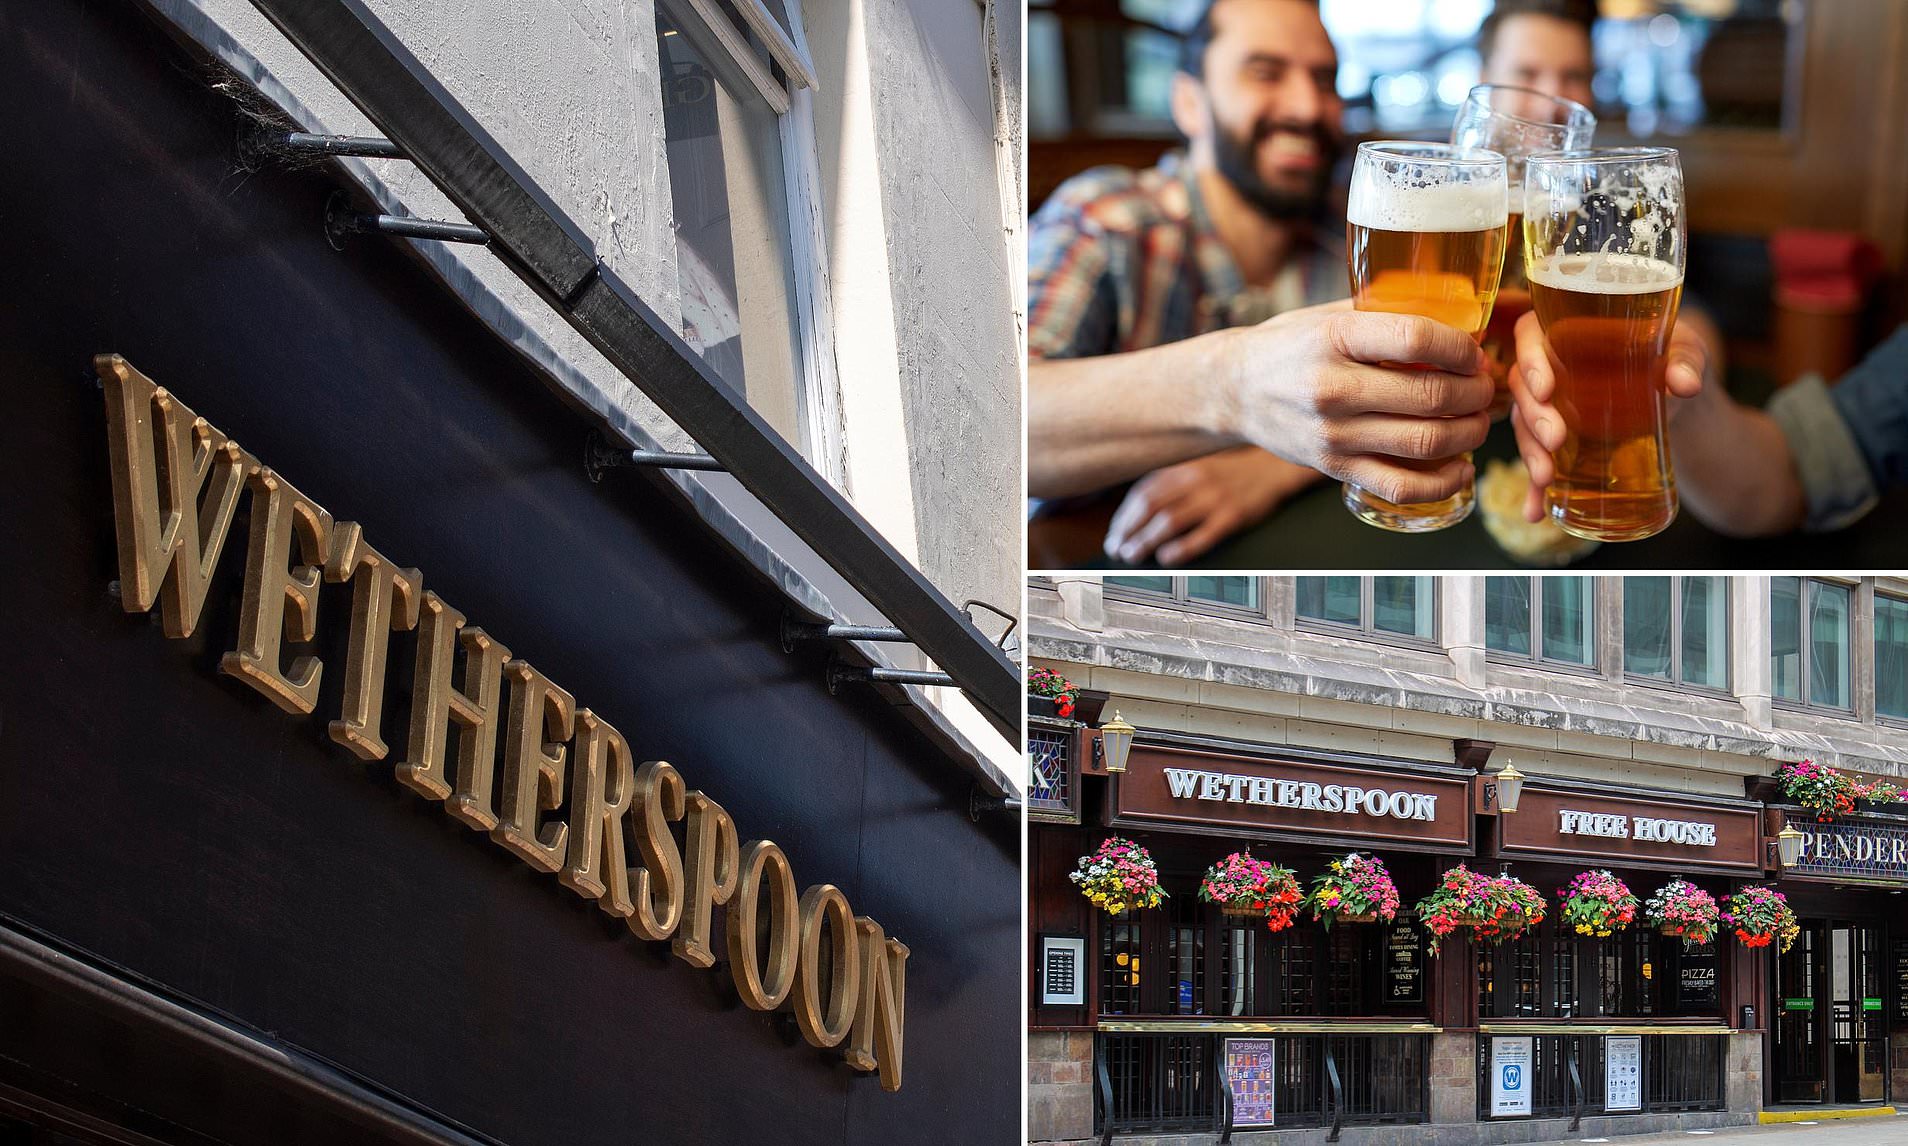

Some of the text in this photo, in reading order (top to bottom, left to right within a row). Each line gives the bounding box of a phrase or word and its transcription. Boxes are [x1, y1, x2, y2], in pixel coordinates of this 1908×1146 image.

[93, 353, 910, 1093] WETHERSPOON
[1163, 767, 1438, 822] WETHERSPOON
[1559, 809, 1717, 846] FREE HOUSE
[1799, 832, 1908, 864] PENDER
[1681, 968, 1715, 979] PIZZA
[1231, 1042, 1269, 1051] TOP BRANDS
